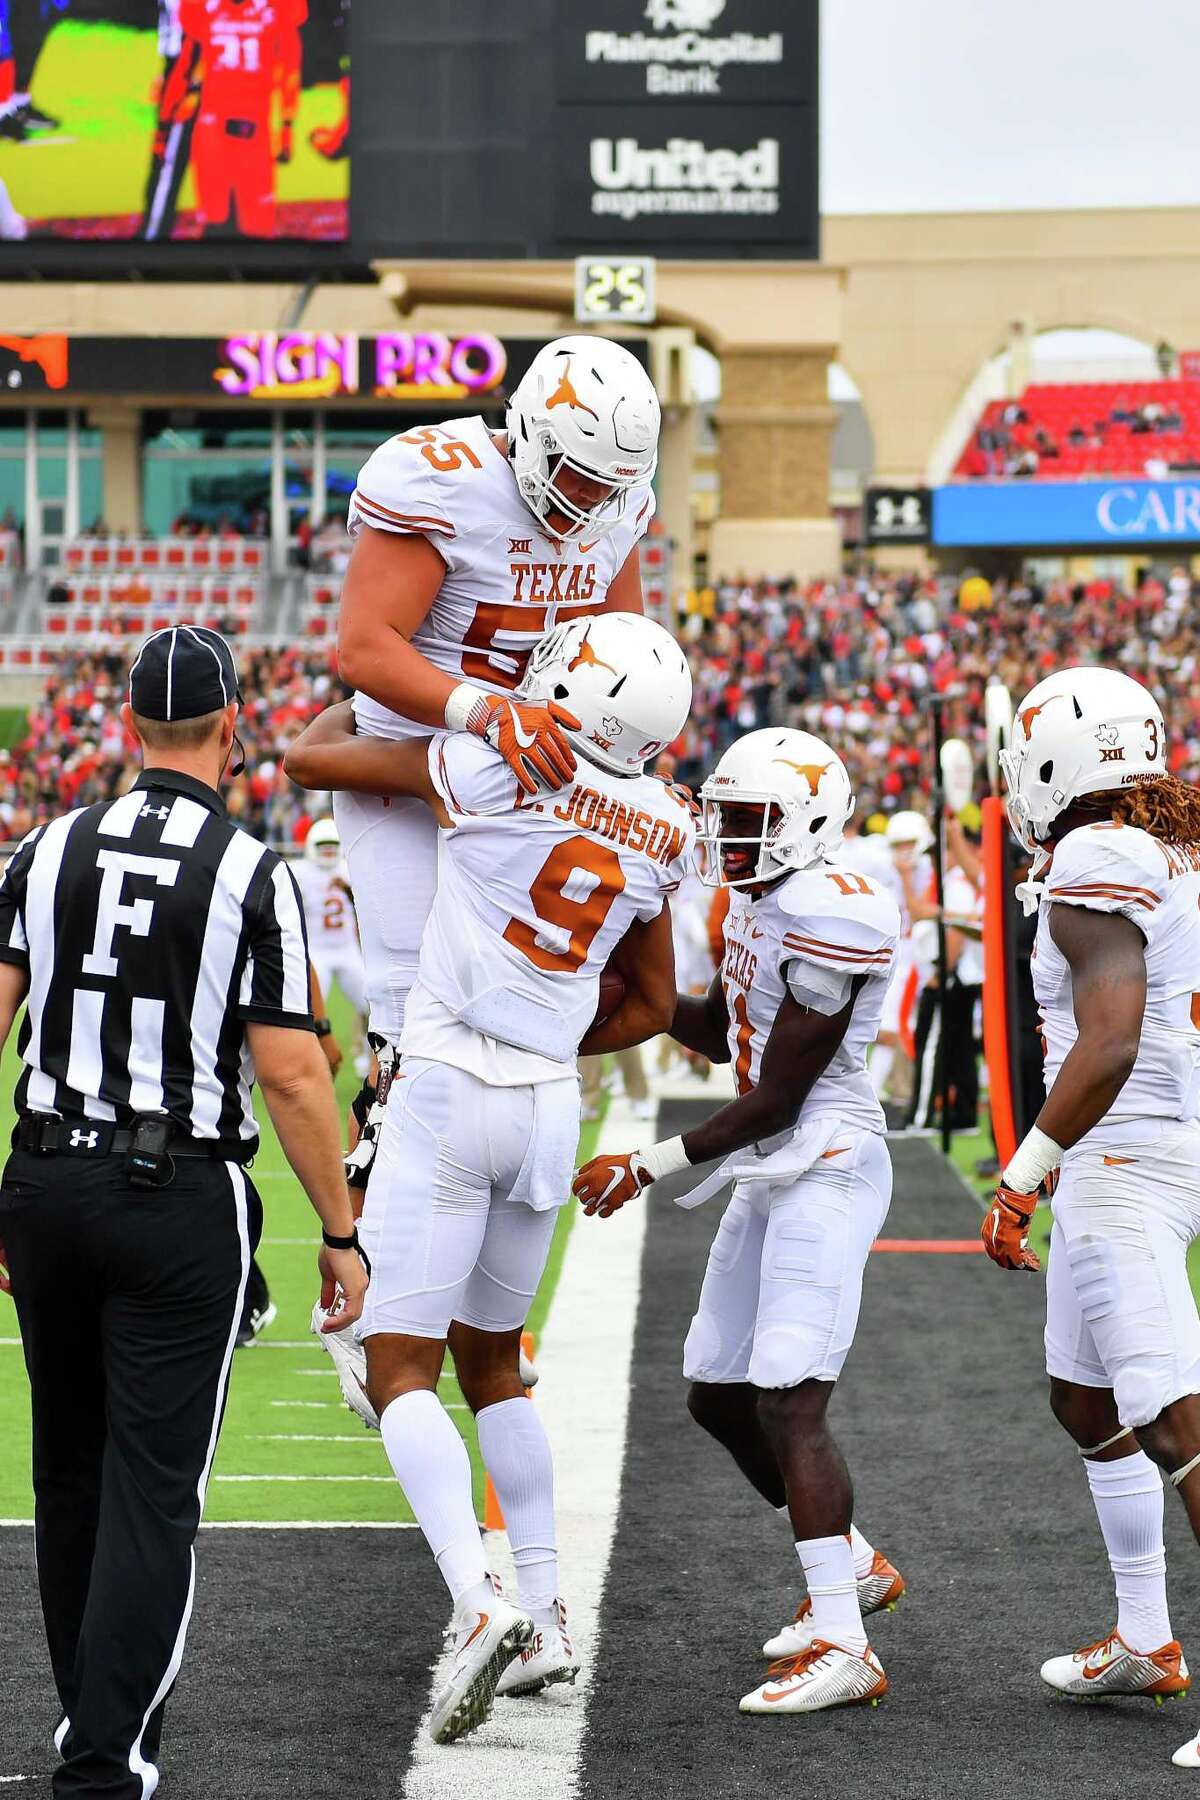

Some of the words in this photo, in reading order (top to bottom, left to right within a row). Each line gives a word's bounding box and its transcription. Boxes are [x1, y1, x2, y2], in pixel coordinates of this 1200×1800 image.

[586, 32, 783, 66] PlainsCapital
[646, 63, 721, 94] Bank
[590, 138, 779, 188] United
[584, 264, 645, 313] 25
[213, 332, 359, 397] SIGN
[375, 332, 507, 390] PRO
[510, 563, 597, 602] TEXAS
[461, 601, 605, 693] 5
[1099, 746, 1126, 763] XII
[553, 784, 688, 868] JOHNSON
[502, 834, 627, 973] 9
[824, 873, 876, 896] 11
[82, 849, 180, 977] F
[323, 898, 344, 928] 2
[725, 937, 758, 993] TEXAS
